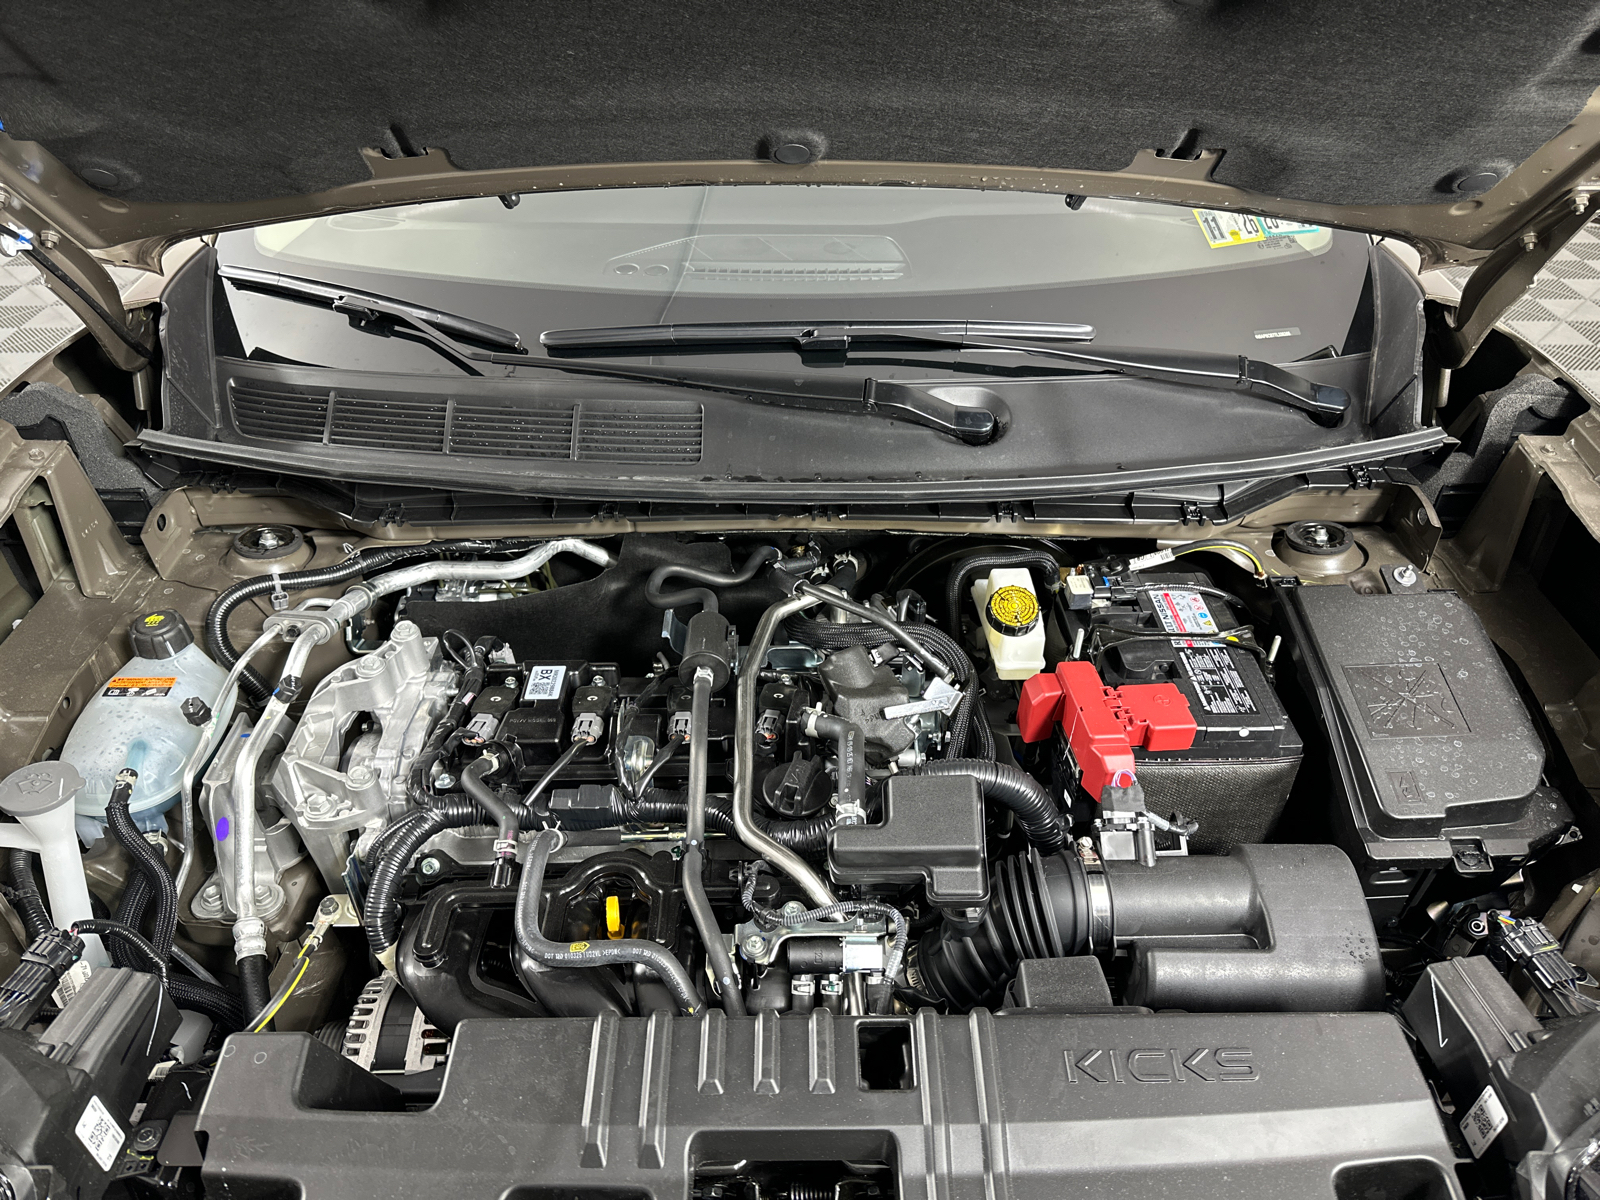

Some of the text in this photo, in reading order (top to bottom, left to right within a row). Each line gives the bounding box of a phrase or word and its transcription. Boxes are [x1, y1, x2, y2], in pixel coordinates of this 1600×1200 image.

[1203, 216, 1224, 240] 11
[1153, 594, 1169, 620] NISSAN
[539, 669, 553, 681] BX
[1063, 1048, 1260, 1084] KICKS
